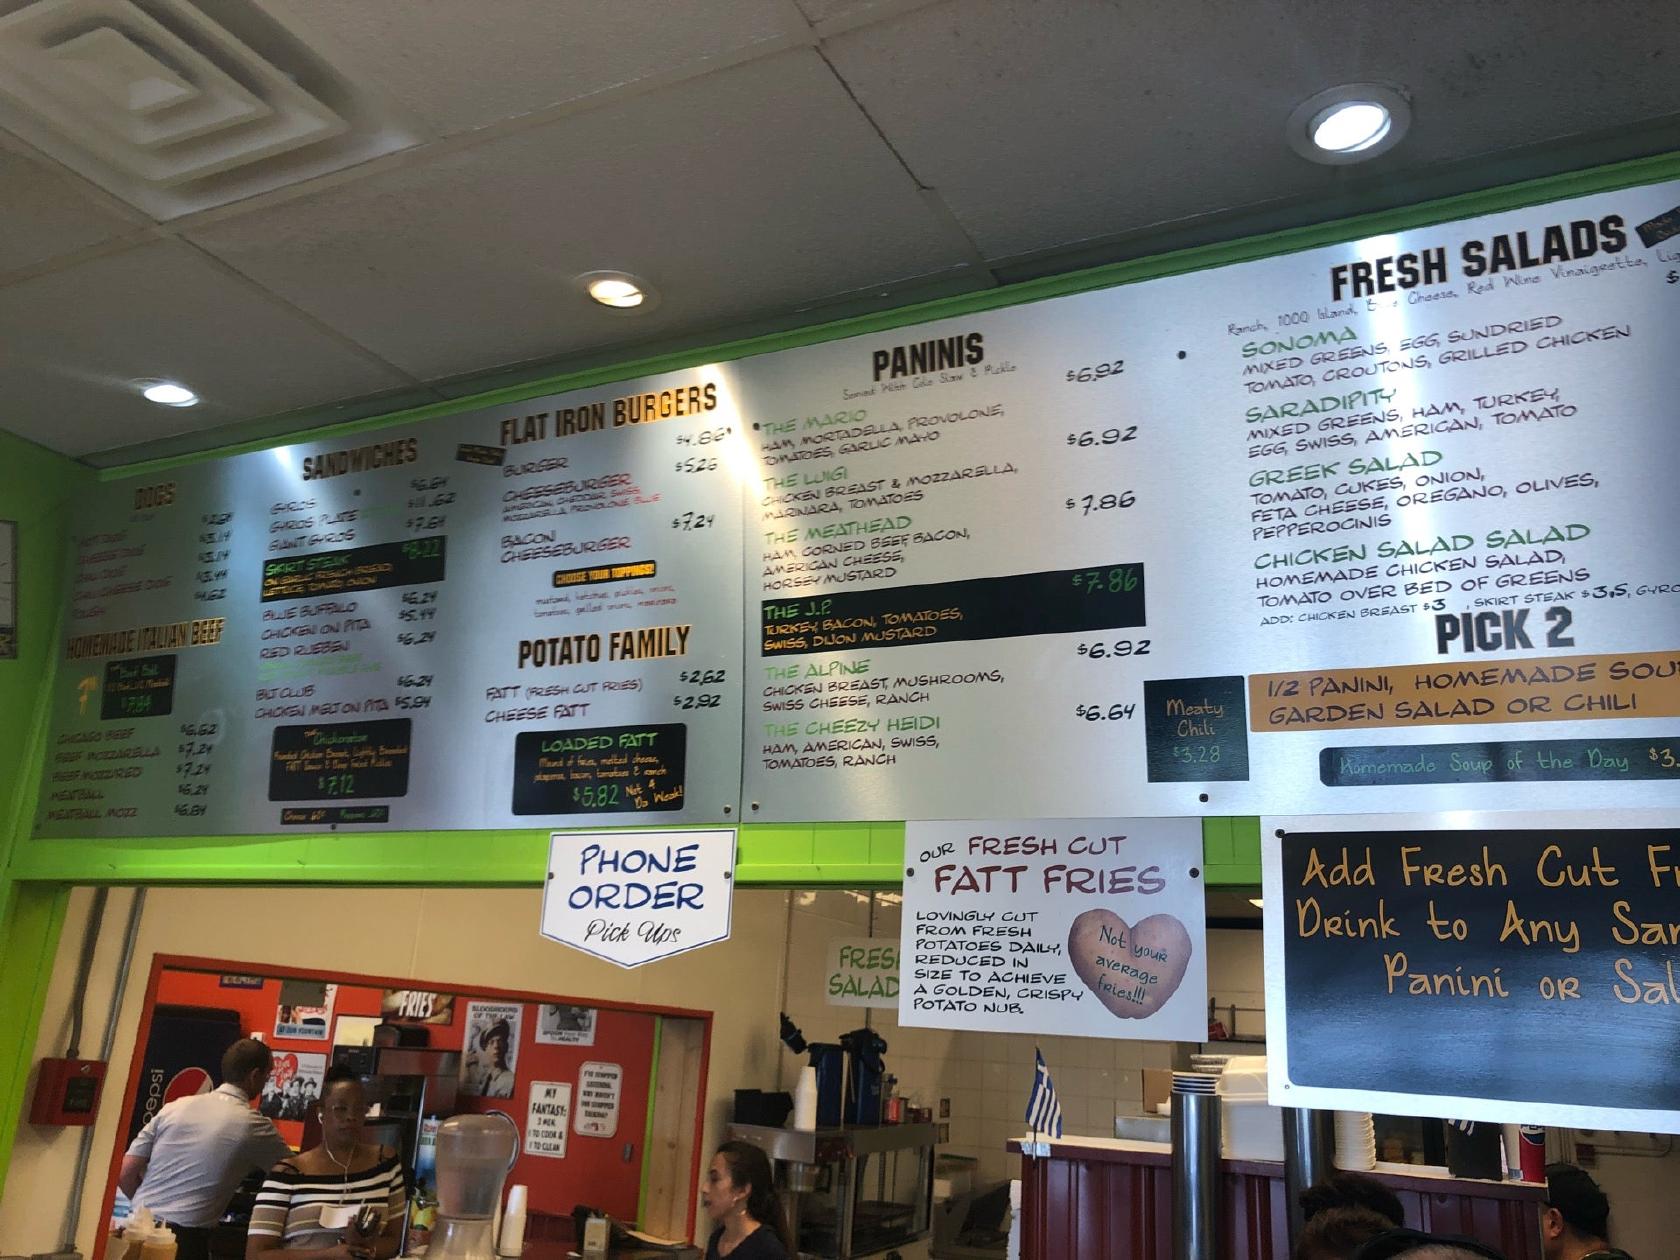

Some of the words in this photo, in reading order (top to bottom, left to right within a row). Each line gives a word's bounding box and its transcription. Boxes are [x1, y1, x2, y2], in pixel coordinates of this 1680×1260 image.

[1331, 247, 1448, 301] FRESH
[1461, 214, 1627, 277] SALADS
[1242, 326, 1358, 358] SONOMA
[872, 332, 984, 382] PANINIS
[1066, 360, 1124, 382] $6.92
[501, 413, 549, 446] FLAT
[556, 402, 606, 438] IRON
[613, 382, 717, 427] BURGERS
[1245, 388, 1396, 424] SARADIPITY
[1246, 422, 1310, 441] MIXED
[1318, 409, 1402, 431] GREENS,
[1413, 401, 1465, 417] HAM,
[1473, 388, 1560, 409] TURKEY,
[303, 437, 417, 480] SANDWICHES
[503, 457, 569, 478] BURGER
[1250, 461, 1340, 487] GREEK
[1349, 451, 1443, 475] SALAD
[503, 472, 633, 501] CHEESEBURGER
[1250, 486, 1327, 505] TOMATO,
[1335, 476, 1406, 495] CUKES,
[1415, 467, 1485, 487] ONION,
[1251, 507, 1297, 522] FETA
[1304, 496, 1388, 517] CHEESE,
[1397, 485, 1507, 507] OREGANO,
[1516, 472, 1599, 494] OLIVES,
[1065, 490, 1136, 516] $7.86
[501, 530, 556, 549] BACON
[765, 529, 799, 545] THE
[804, 515, 912, 542] MEATHEAD
[1252, 514, 1392, 541] PEPPEROCINIS
[501, 536, 632, 564] CHEESEBURGER
[1254, 544, 1366, 570] CHICKEN
[1377, 535, 1474, 559] SALAD
[1486, 524, 1591, 549] SALAD
[1072, 568, 1138, 594] $7.86
[1256, 565, 1379, 589] HOMEMADE
[1386, 556, 1476, 577] CHICKEN
[1485, 550, 1565, 568] SALAD,
[1256, 591, 1337, 608] TOMATO
[1340, 585, 1397, 601] OVER
[1404, 580, 1452, 596] BED
[1461, 576, 1489, 592] OF
[1496, 568, 1590, 589] GREENS
[763, 604, 799, 620] THE
[1260, 615, 1293, 626] ADD:
[1298, 610, 1356, 622] CHICKEN
[1360, 604, 1418, 618] BREAST
[1435, 608, 1535, 655] PICK
[1545, 606, 1575, 647] 2
[518, 634, 601, 669] POTATO
[608, 625, 692, 662] FAMILY
[1077, 640, 1151, 659] $6.92
[680, 670, 726, 686] $2.62
[763, 683, 822, 697] CHICKEN
[828, 677, 889, 693] BREAST,
[893, 669, 1004, 688] MUSHROOMS,
[765, 665, 800, 680] THE
[804, 659, 871, 678] ALPINE
[1268, 680, 1299, 698] 1/2
[1309, 675, 1393, 696] PANINI,
[1415, 663, 1596, 690] HOMEMADE
[1609, 661, 1680, 680] SOU
[486, 685, 521, 701] FATT
[573, 682, 598, 694] CUT
[673, 694, 722, 710] $2.92
[763, 701, 804, 713] SWISS
[809, 696, 871, 710] CHEESE,
[876, 692, 930, 705] RANCH
[485, 705, 548, 724] CHEESE
[554, 703, 591, 718] FATT
[1076, 703, 1136, 721] $6.64
[1166, 698, 1224, 718] Meaty
[1269, 703, 1384, 725] GARDEN
[1394, 698, 1495, 720] SALAD
[1507, 696, 1552, 714] OR
[1564, 693, 1637, 711] CHILI
[763, 722, 799, 738] THE
[805, 718, 880, 735] CHEEZY
[887, 715, 940, 732] HEIDI
[1177, 719, 1216, 737] Chili
[542, 735, 613, 753] LOADED
[619, 732, 659, 749] FATT
[763, 743, 797, 756] HAM,
[802, 738, 885, 754] AMERICAN,
[891, 735, 939, 750] SWISS,
[1173, 745, 1221, 764] $3.28
[763, 756, 837, 770] TOMATOES,
[843, 754, 896, 767] RANCH
[1340, 754, 1437, 776] Homemade
[1450, 752, 1492, 774] Soup
[1507, 750, 1522, 769] of
[1536, 751, 1574, 768] the
[1588, 748, 1629, 773] Day
[581, 844, 699, 875] PHONE
[919, 842, 955, 863] OUR
[968, 835, 1057, 857] FRESH
[1067, 835, 1128, 856] CUT
[1301, 846, 1376, 888] Add
[1536, 844, 1619, 888] Cut
[934, 864, 1028, 896] FATT
[1043, 864, 1167, 895] FRIES
[568, 881, 704, 910] ORDER
[916, 910, 995, 922] LOVINGLY
[1001, 911, 1040, 923] CUT
[1426, 900, 1468, 941] to
[1499, 899, 1580, 954] Any
[584, 918, 630, 943] Pick
[637, 920, 681, 945] Ups
[916, 924, 966, 937] FROM
[972, 925, 1032, 938] FRESH
[1099, 925, 1127, 949] Not
[1134, 945, 1168, 963] your
[914, 954, 1006, 968] REDUCED
[1012, 956, 1029, 969] IN
[916, 939, 1003, 953] POTATOES
[1009, 940, 1062, 957] DAILY,
[914, 968, 953, 981] SIZE
[960, 970, 982, 983] TO
[987, 971, 1067, 985] ACHIEVE
[1095, 954, 1159, 985] average
[1383, 951, 1509, 999] Panini
[914, 983, 927, 997] A
[933, 984, 1011, 1000] GOLDEN,
[1017, 987, 1084, 1002] CRISPY
[1097, 973, 1147, 1006] fries!!!
[399, 990, 436, 1017] FRIES
[913, 997, 978, 1012] POTATO
[983, 1001, 1025, 1015] NUB.
